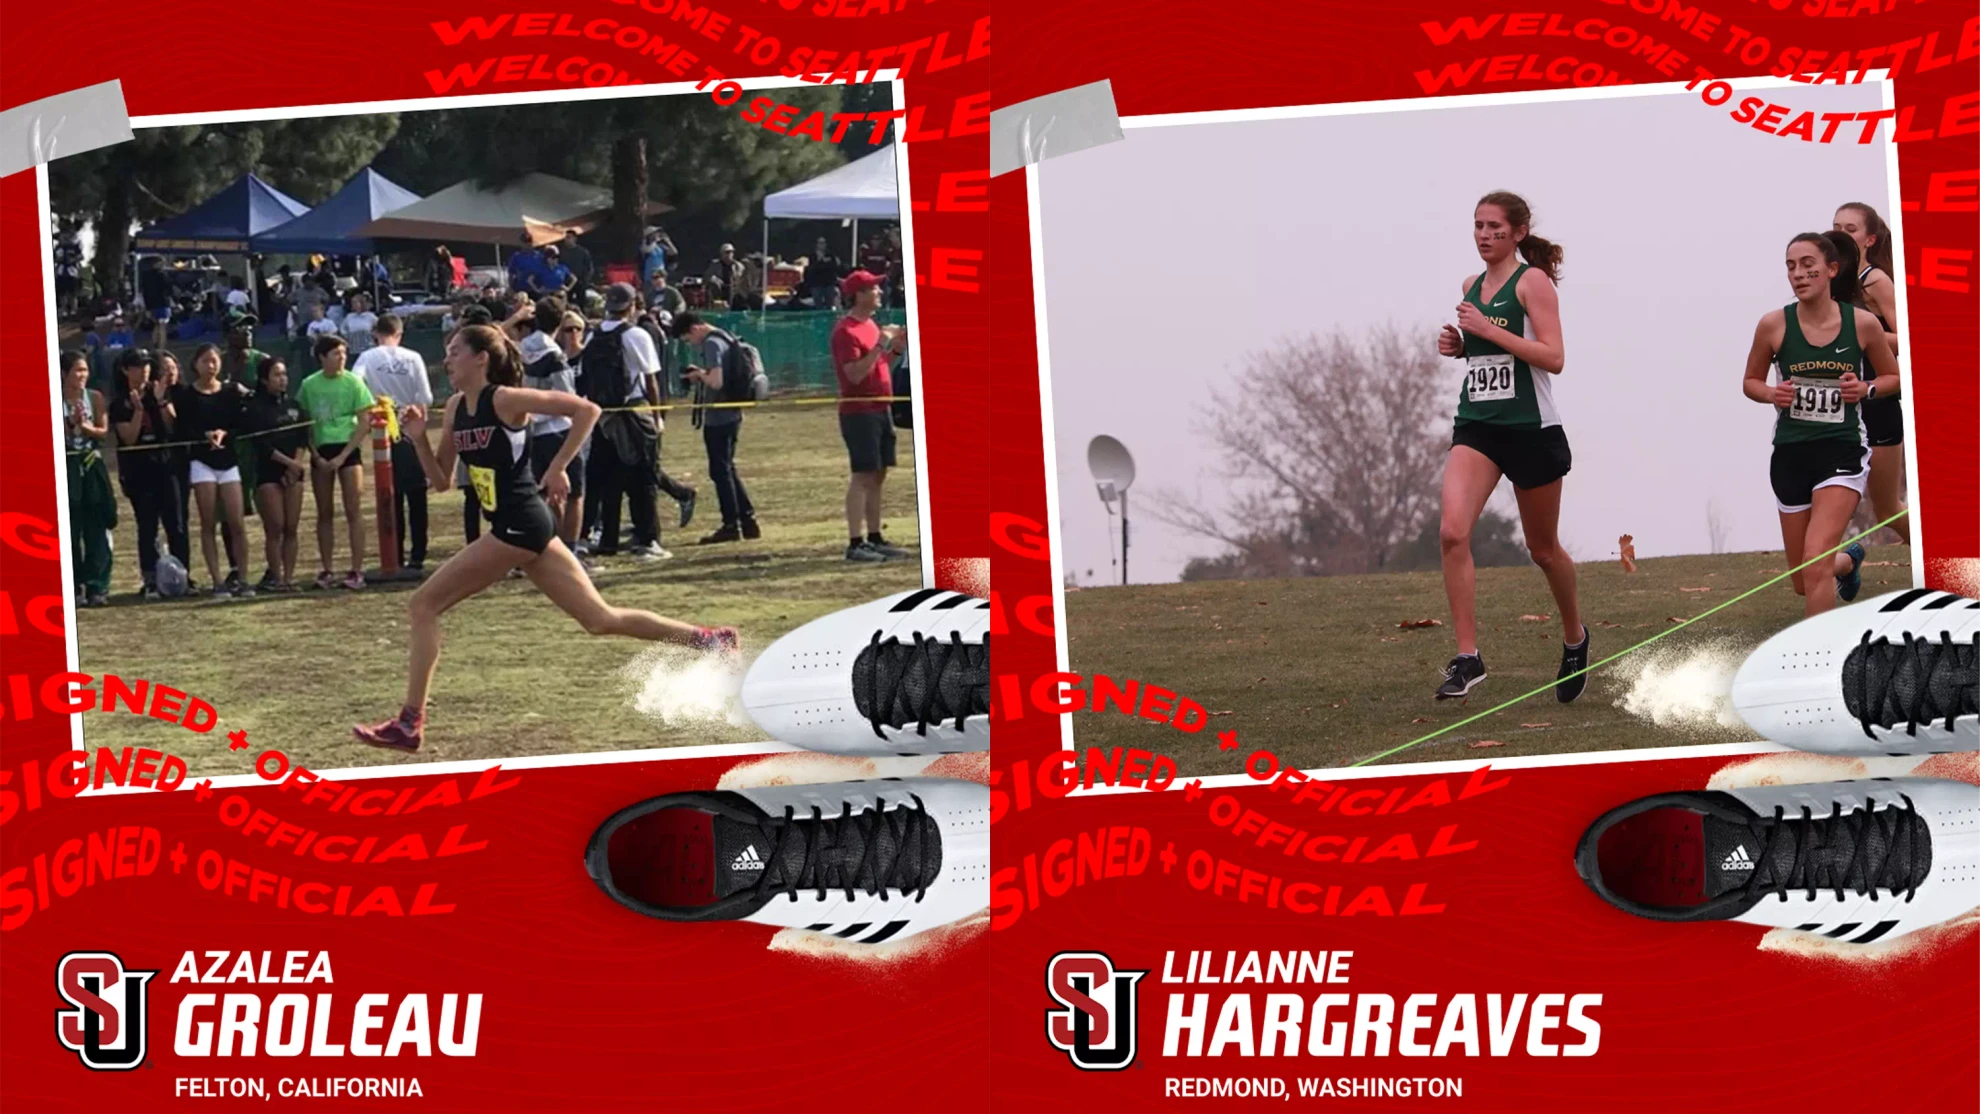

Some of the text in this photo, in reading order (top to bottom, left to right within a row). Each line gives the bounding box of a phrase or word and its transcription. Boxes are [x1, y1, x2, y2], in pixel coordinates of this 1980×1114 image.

[1789, 360, 1854, 374] REDMOND
[1469, 366, 1511, 393] 1920
[1793, 386, 1842, 414] 1919
[732, 860, 765, 870] adidas
[1722, 860, 1755, 870] adidas
